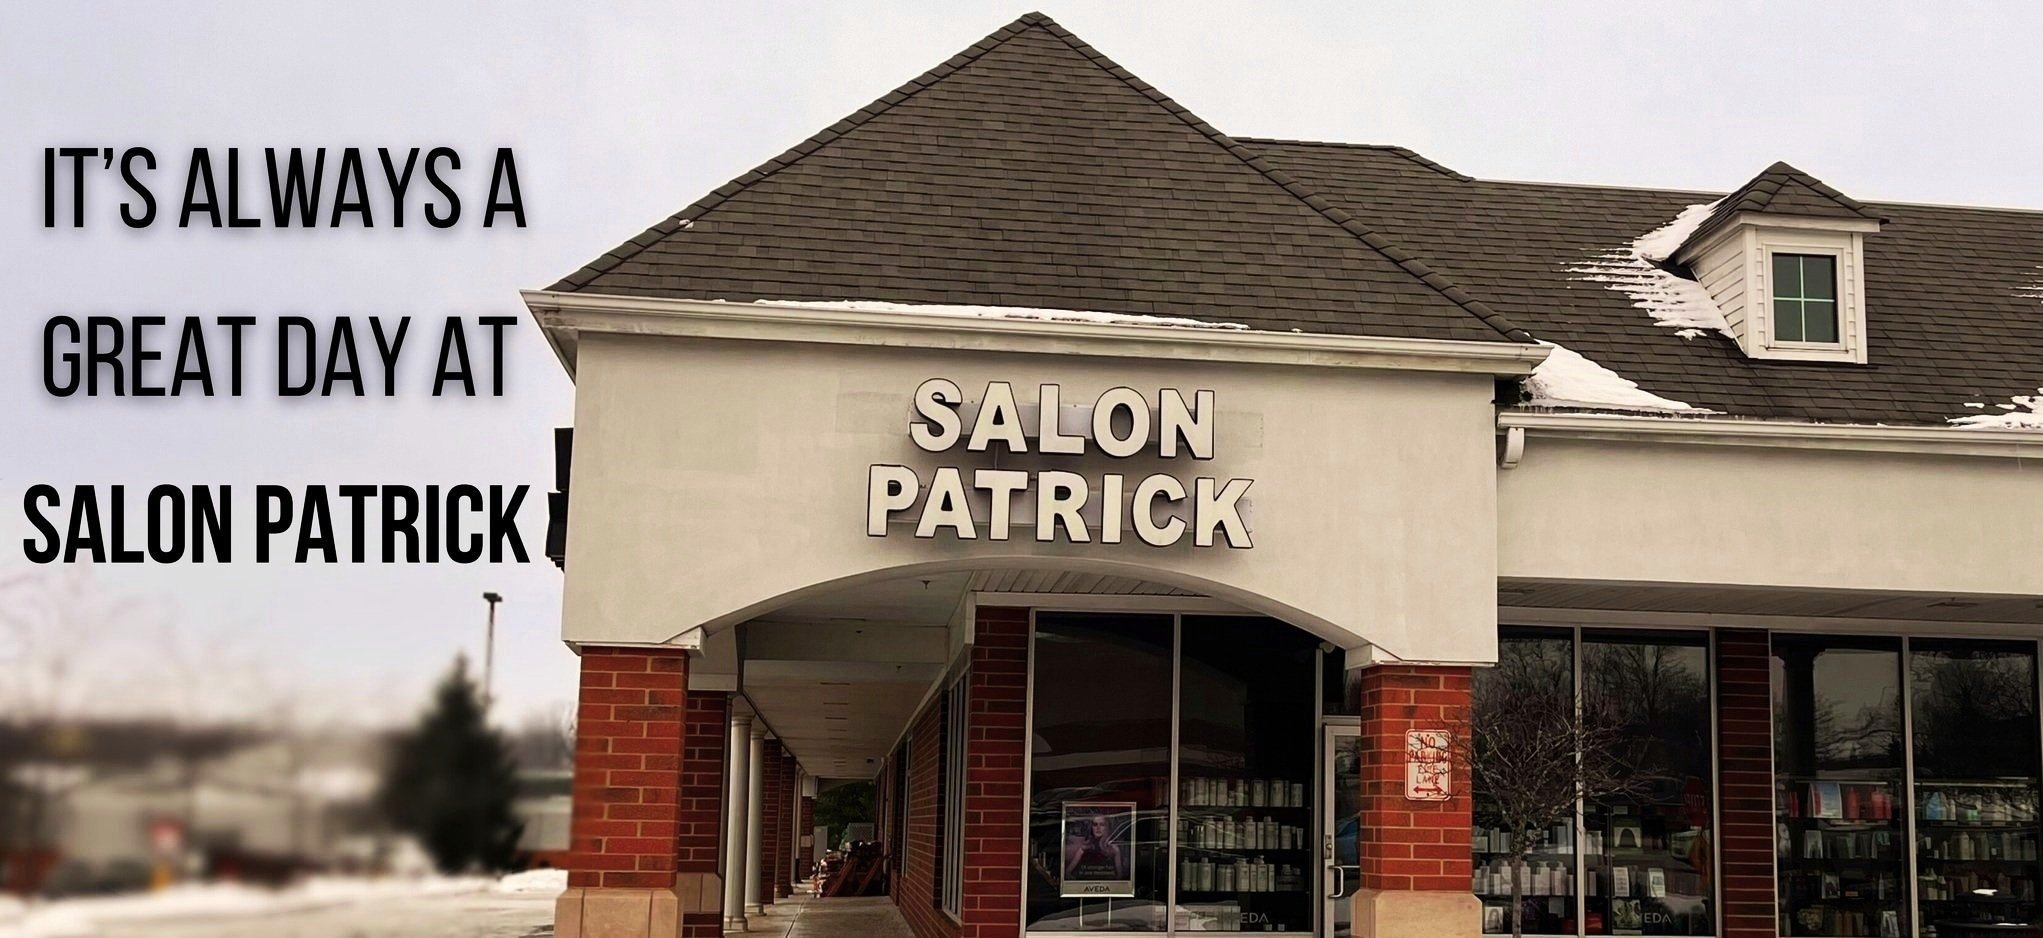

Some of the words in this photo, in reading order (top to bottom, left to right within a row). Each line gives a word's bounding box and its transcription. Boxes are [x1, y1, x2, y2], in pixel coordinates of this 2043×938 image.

[909, 377, 1215, 460] SALON
[867, 463, 1254, 549] PATRICK
[1420, 736, 1436, 750] NO
[1083, 885, 1111, 893] AVEDA
